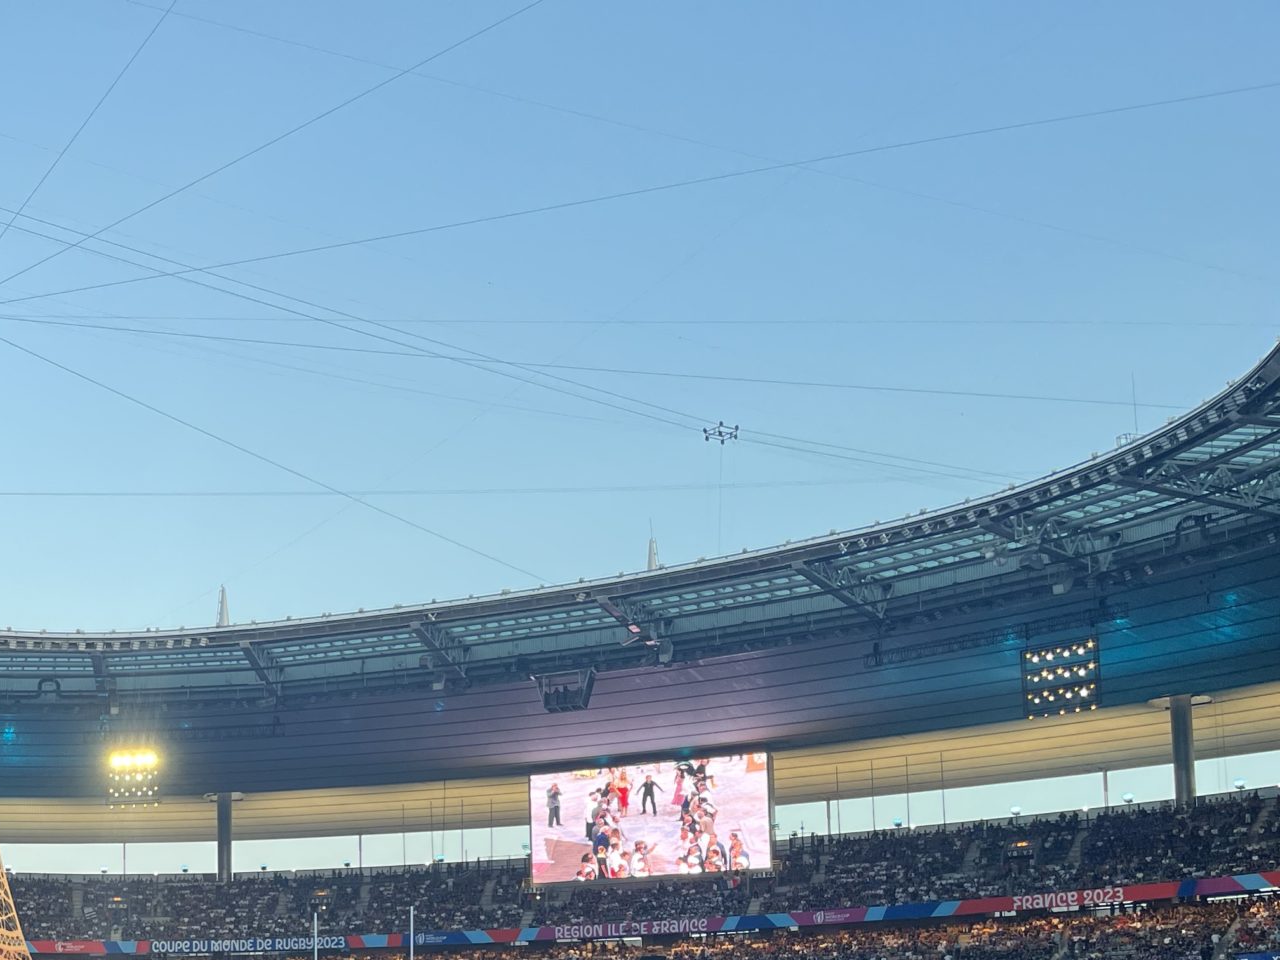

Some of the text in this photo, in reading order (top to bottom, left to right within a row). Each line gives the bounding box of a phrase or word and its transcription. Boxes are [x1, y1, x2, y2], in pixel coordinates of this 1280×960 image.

[1012, 887, 1124, 910] FRANCE 2023
[651, 918, 708, 934] FRANCE
[151, 936, 345, 953] COUPE DU MONDE DE RUGBY 2023
